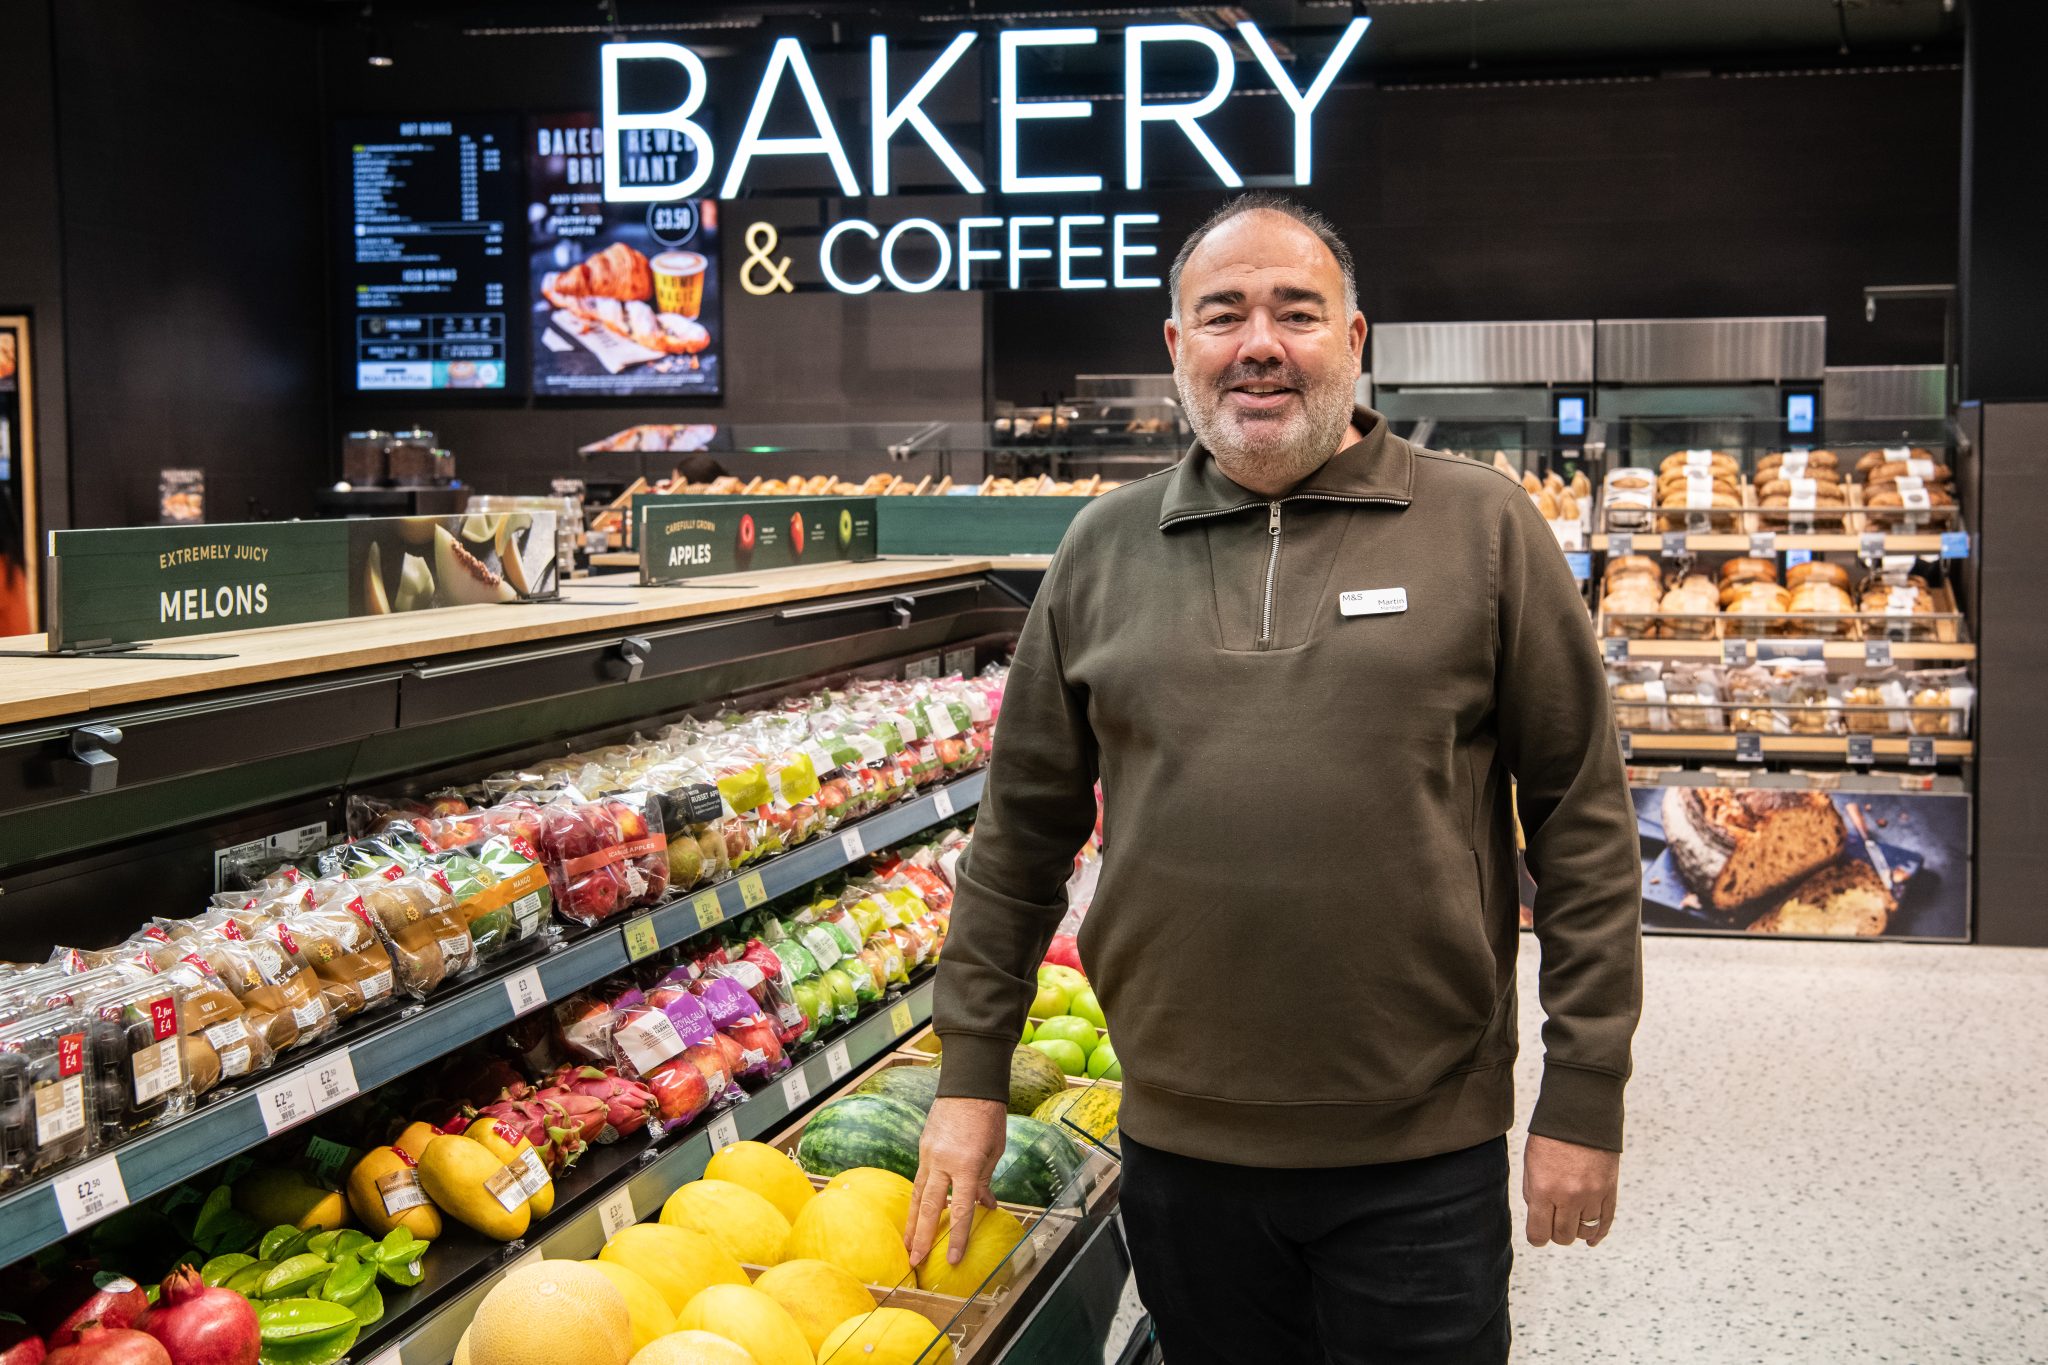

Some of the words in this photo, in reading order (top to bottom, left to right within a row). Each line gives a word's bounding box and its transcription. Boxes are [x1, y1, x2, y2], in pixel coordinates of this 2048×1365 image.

[601, 17, 1372, 201] BAKERY
[739, 220, 794, 296] &
[819, 213, 1162, 295] COFFEE
[665, 519, 696, 535] CAREFULLY
[160, 544, 231, 569] EXTREMELY
[234, 545, 268, 562] JUICY
[668, 543, 712, 567] APPLES
[161, 583, 268, 623] MELONS
[1343, 593, 1363, 602] M&S
[1378, 598, 1405, 606] Martin
[628, 842, 655, 854] APPLES
[513, 875, 531, 888] MANGO
[156, 1006, 163, 1019] 2
[162, 1007, 173, 1018] for
[160, 1019, 171, 1033] £4
[680, 1022, 702, 1039] APPLES
[63, 1040, 68, 1053] 2
[68, 1042, 80, 1053] for
[65, 1057, 77, 1069] £4
